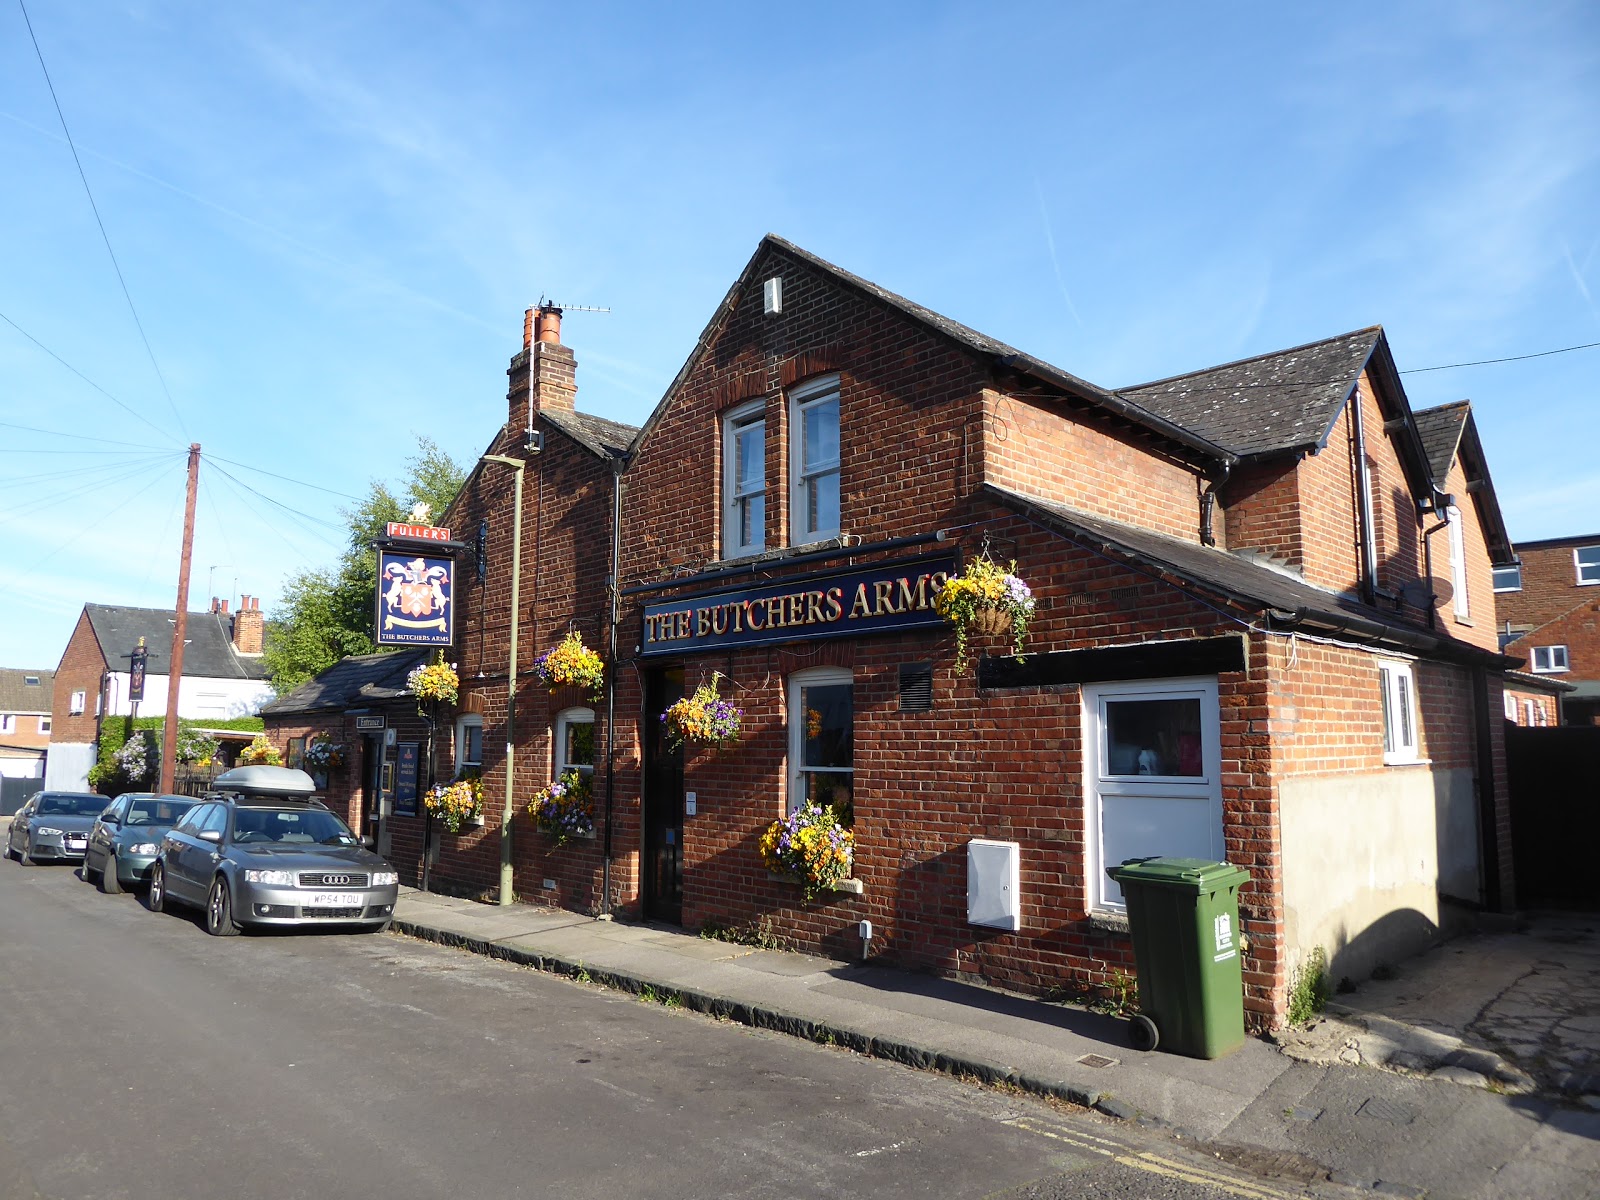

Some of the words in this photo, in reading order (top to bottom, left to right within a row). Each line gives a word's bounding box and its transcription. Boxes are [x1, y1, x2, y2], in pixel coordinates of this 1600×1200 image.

[646, 609, 693, 643] THE
[695, 587, 843, 637] BUTCHERS
[848, 571, 948, 619] ARMS
[314, 894, 338, 904] WP54
